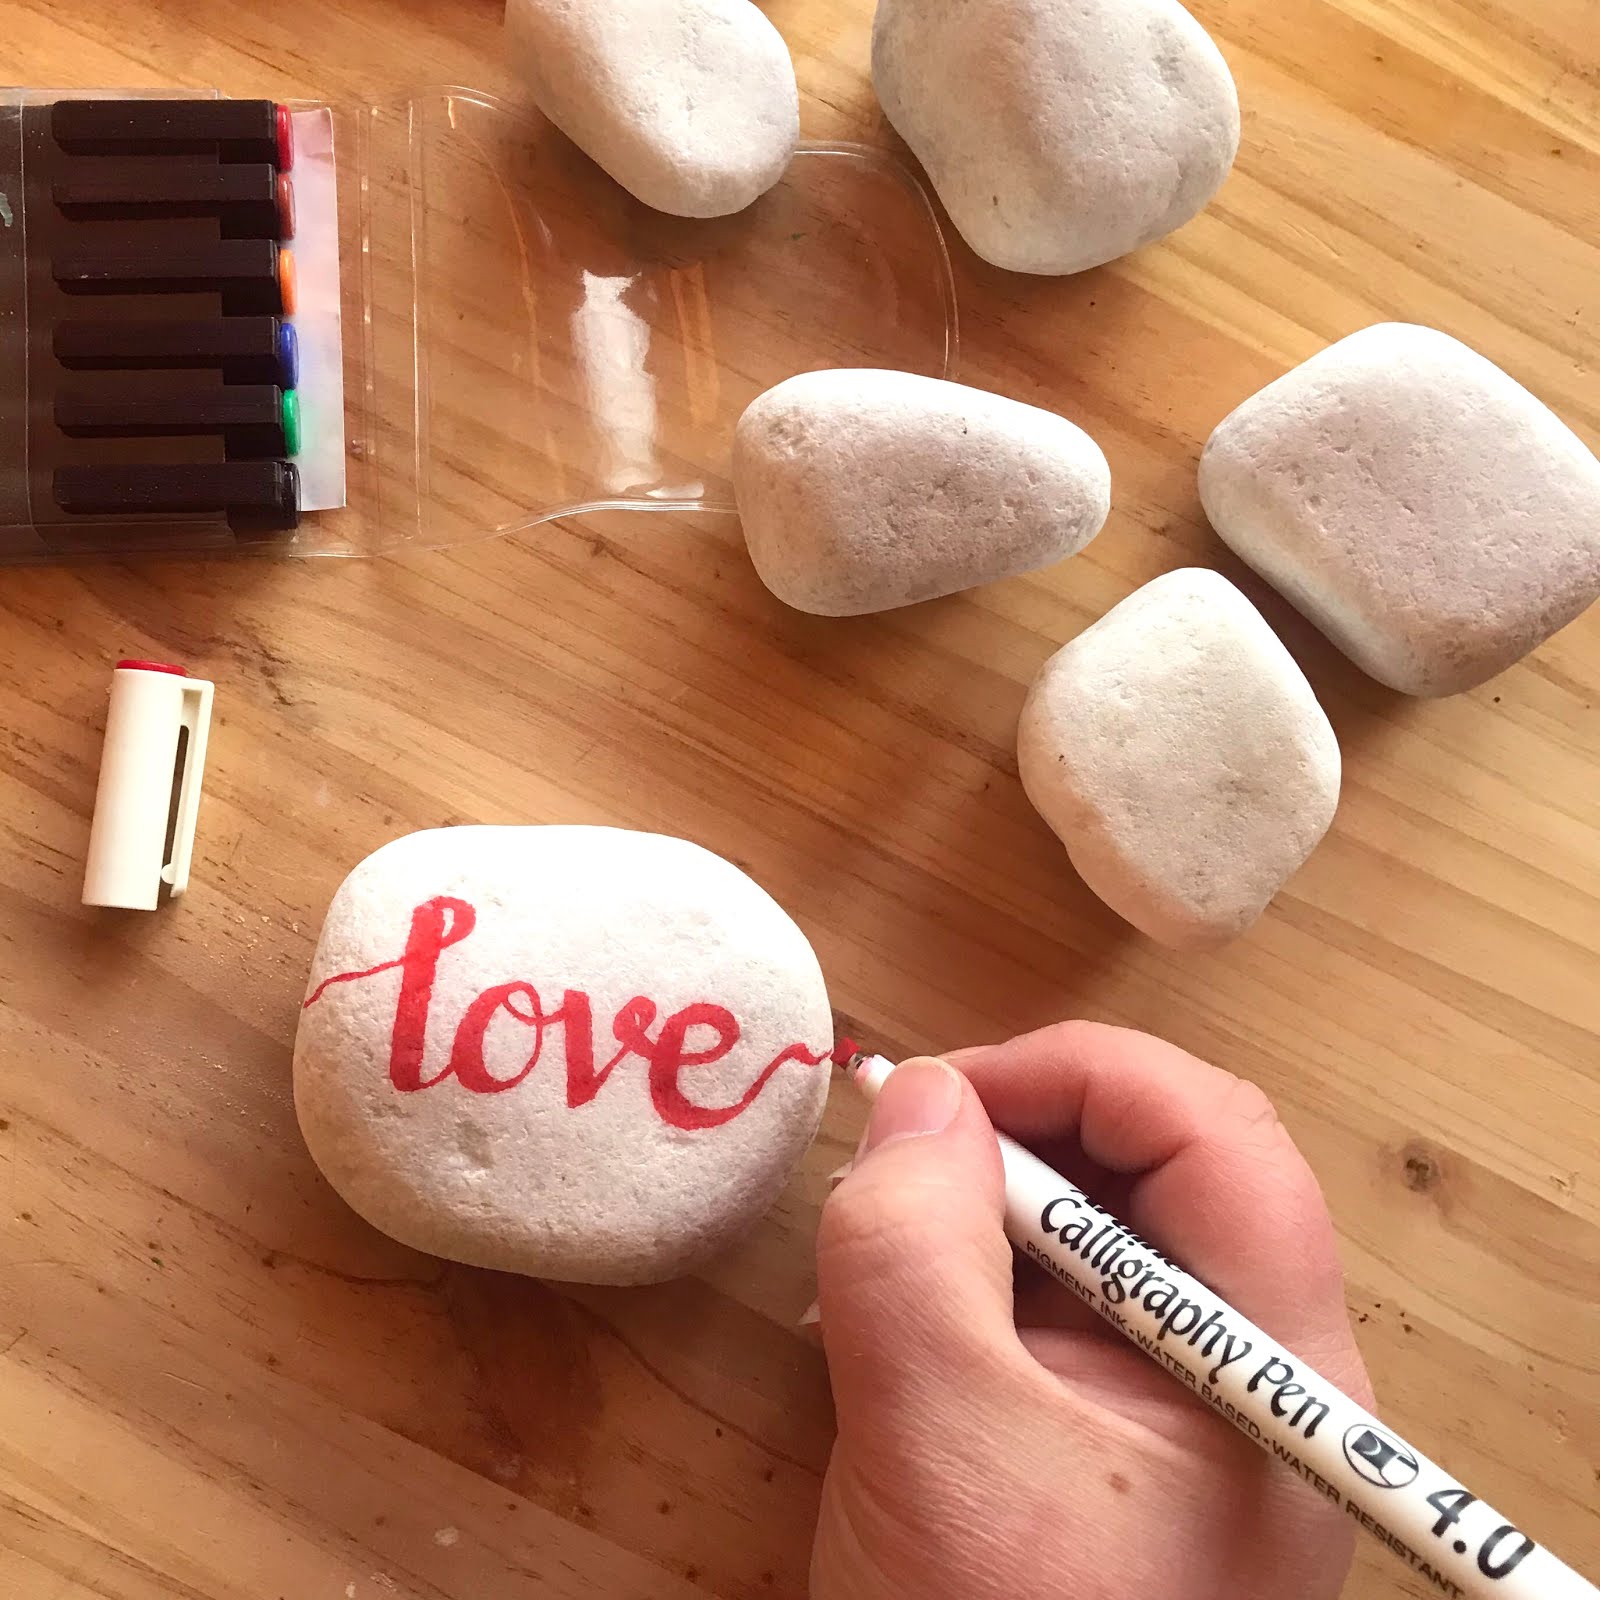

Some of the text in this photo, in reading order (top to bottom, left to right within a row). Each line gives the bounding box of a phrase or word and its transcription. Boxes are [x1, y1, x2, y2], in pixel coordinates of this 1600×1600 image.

[303, 896, 831, 1130] love
[1026, 1241, 1096, 1302] PIGMENT
[1345, 1499, 1465, 1599] RESISTANT
[1041, 1197, 1252, 1384] Calligraphy
[1247, 1356, 1330, 1439] Pen
[1426, 1489, 1536, 1580] 4.0
